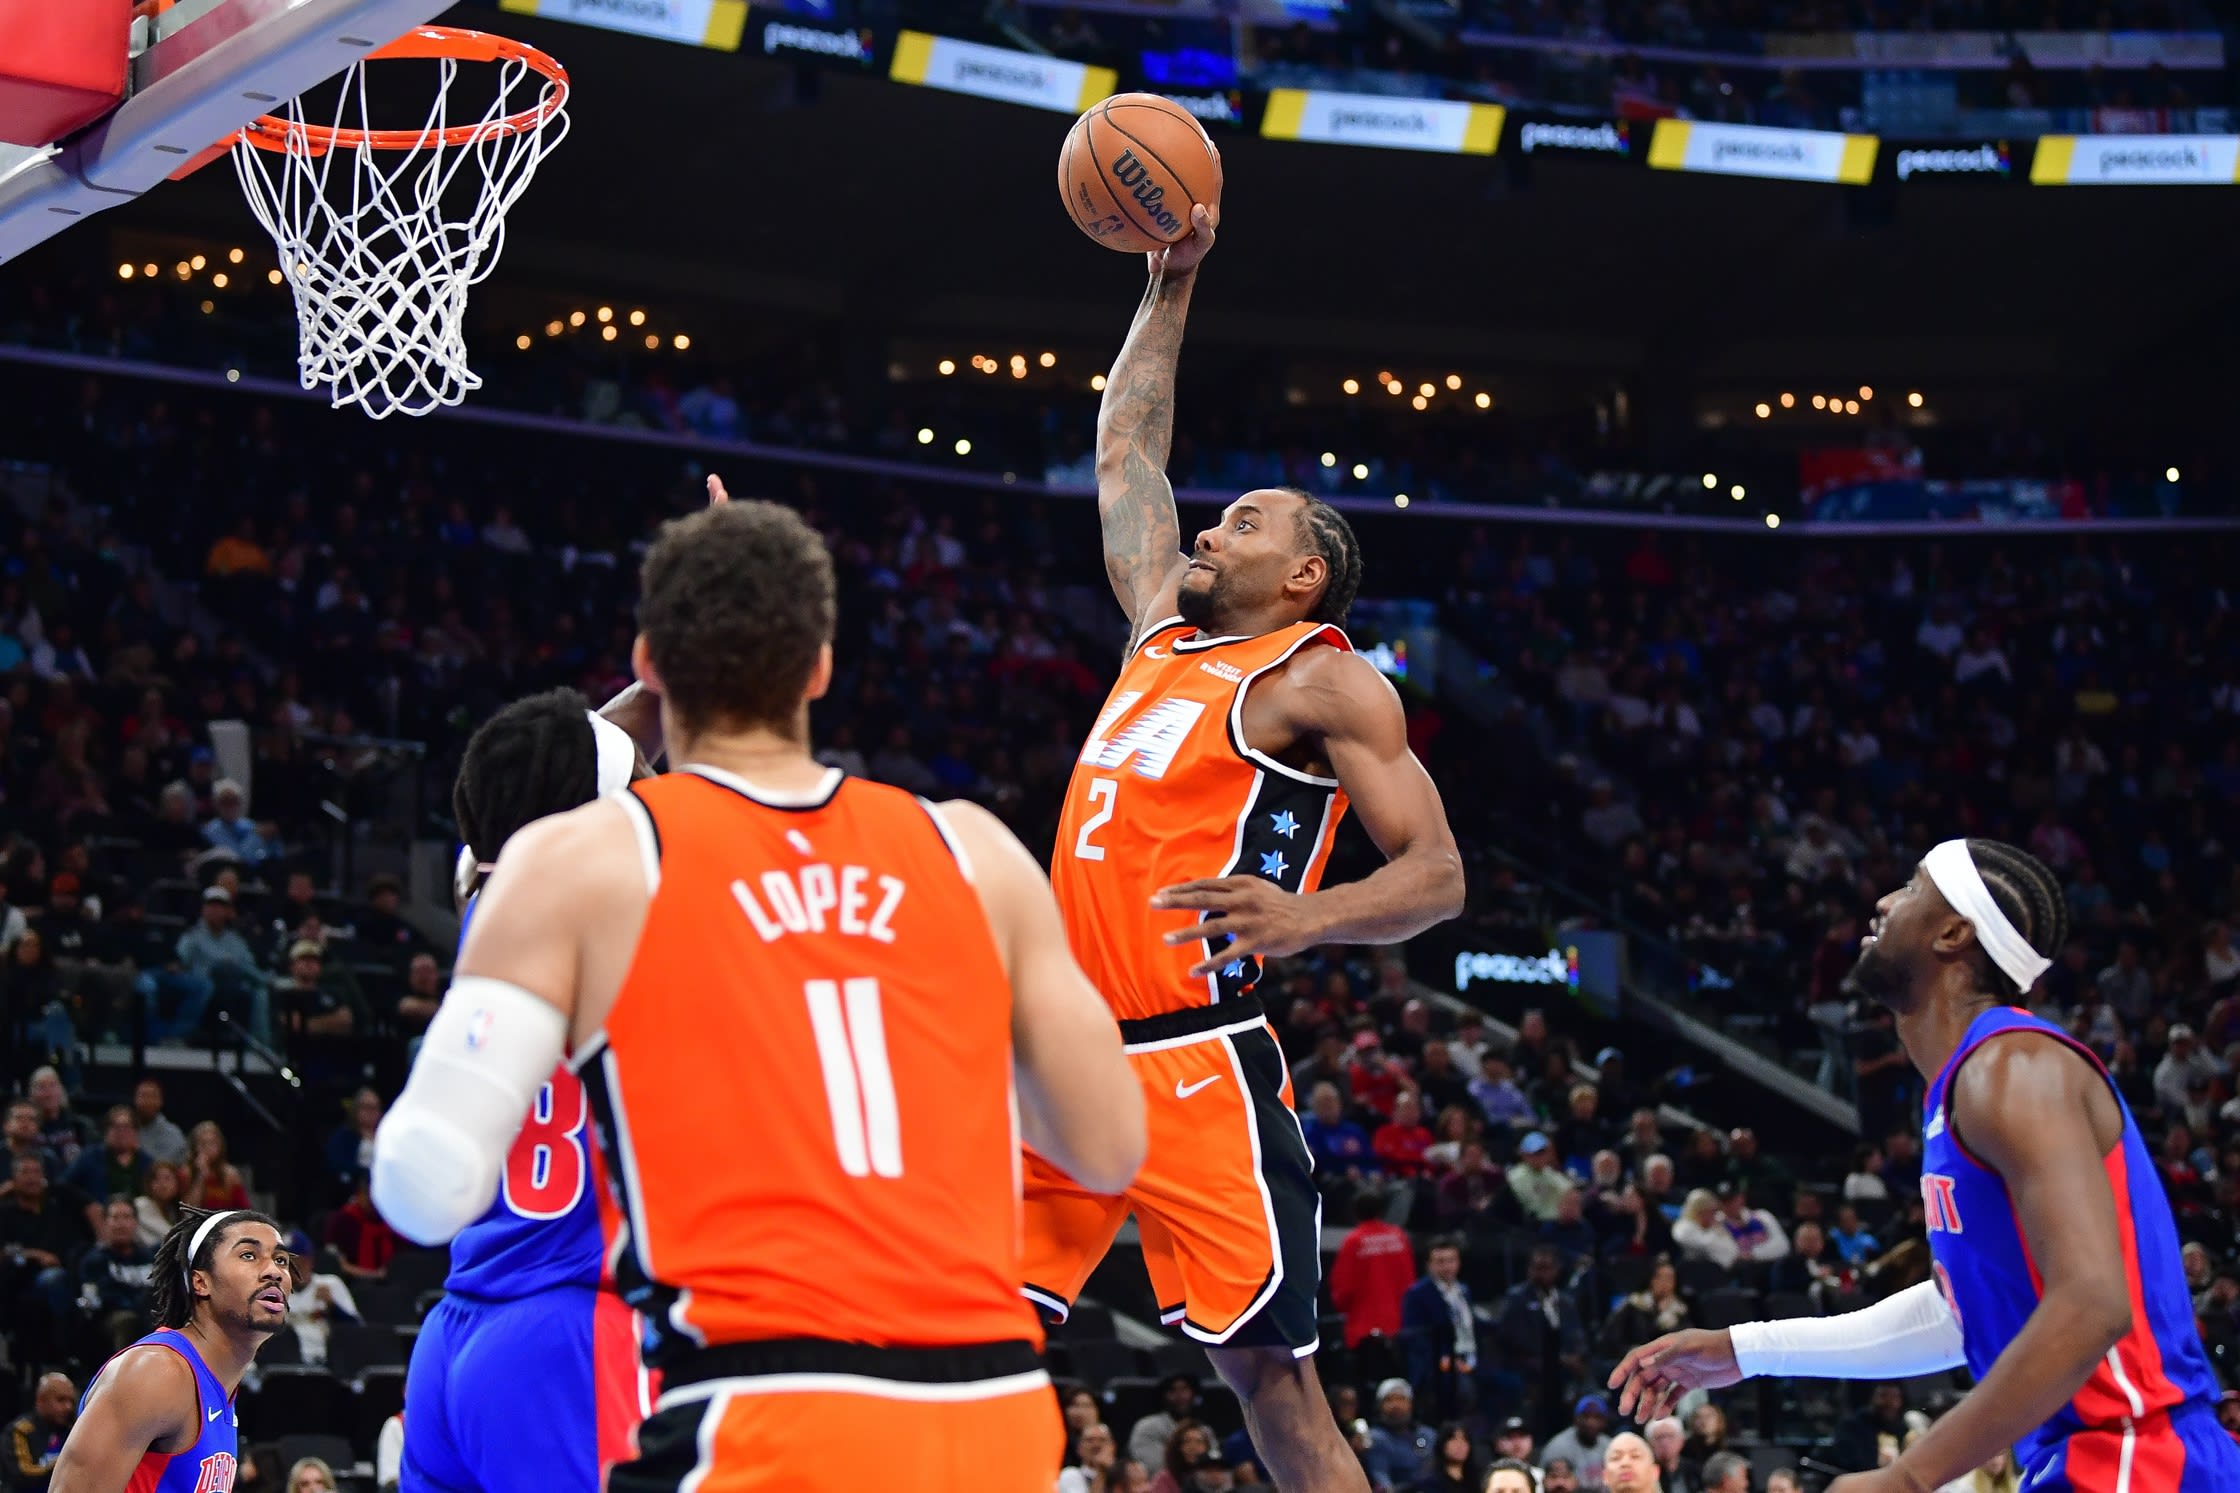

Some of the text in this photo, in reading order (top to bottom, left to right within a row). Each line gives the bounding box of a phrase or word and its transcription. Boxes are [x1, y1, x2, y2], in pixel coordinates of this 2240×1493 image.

[1521, 121, 1619, 153] peacock
[1897, 143, 1999, 182] peacock
[2099, 141, 2199, 173] peacock
[1112, 147, 1183, 237] Wilson
[1215, 660, 1243, 676] VISIT
[1079, 690, 1206, 781] LA
[1074, 777, 1118, 861] 2
[730, 863, 906, 944] LOPEZ
[1455, 948, 1567, 991] peacock
[804, 977, 902, 1178] 11
